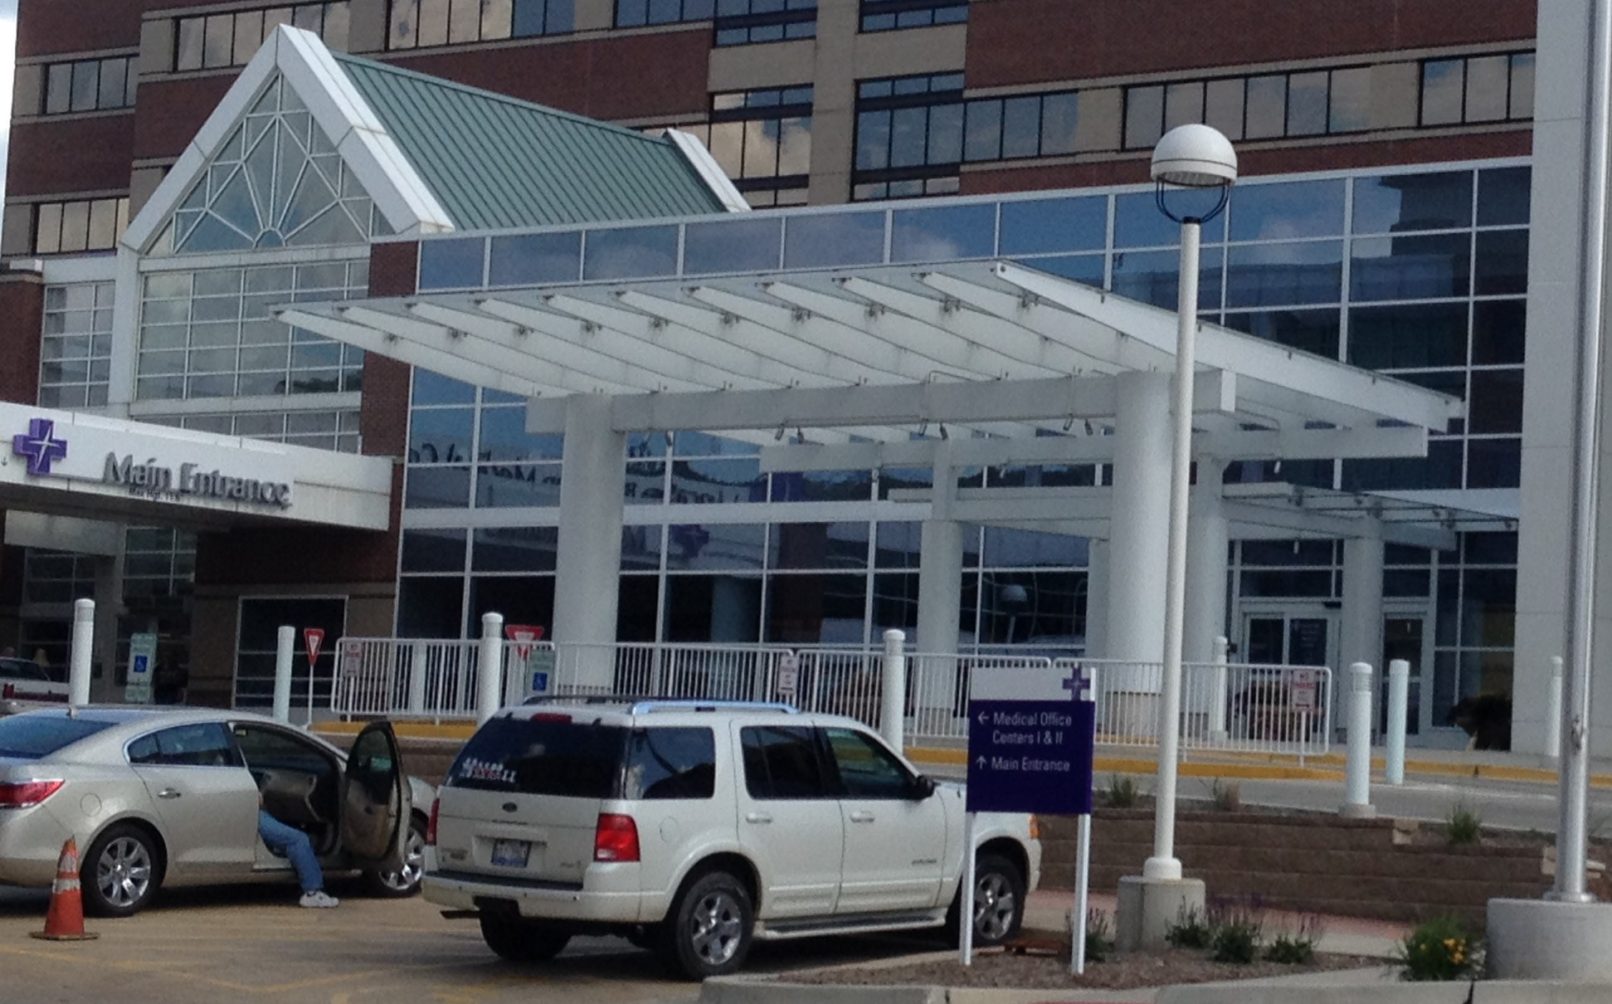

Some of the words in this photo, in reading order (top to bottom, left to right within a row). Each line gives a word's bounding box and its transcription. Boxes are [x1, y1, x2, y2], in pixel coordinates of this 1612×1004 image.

[178, 462, 293, 508] Entrance
[993, 711, 1038, 726] Medical
[1040, 711, 1073, 727] Office
[992, 730, 1034, 745] Centers
[1043, 730, 1053, 746] &
[992, 756, 1019, 771] Main
[1021, 756, 1071, 772] Entrance
